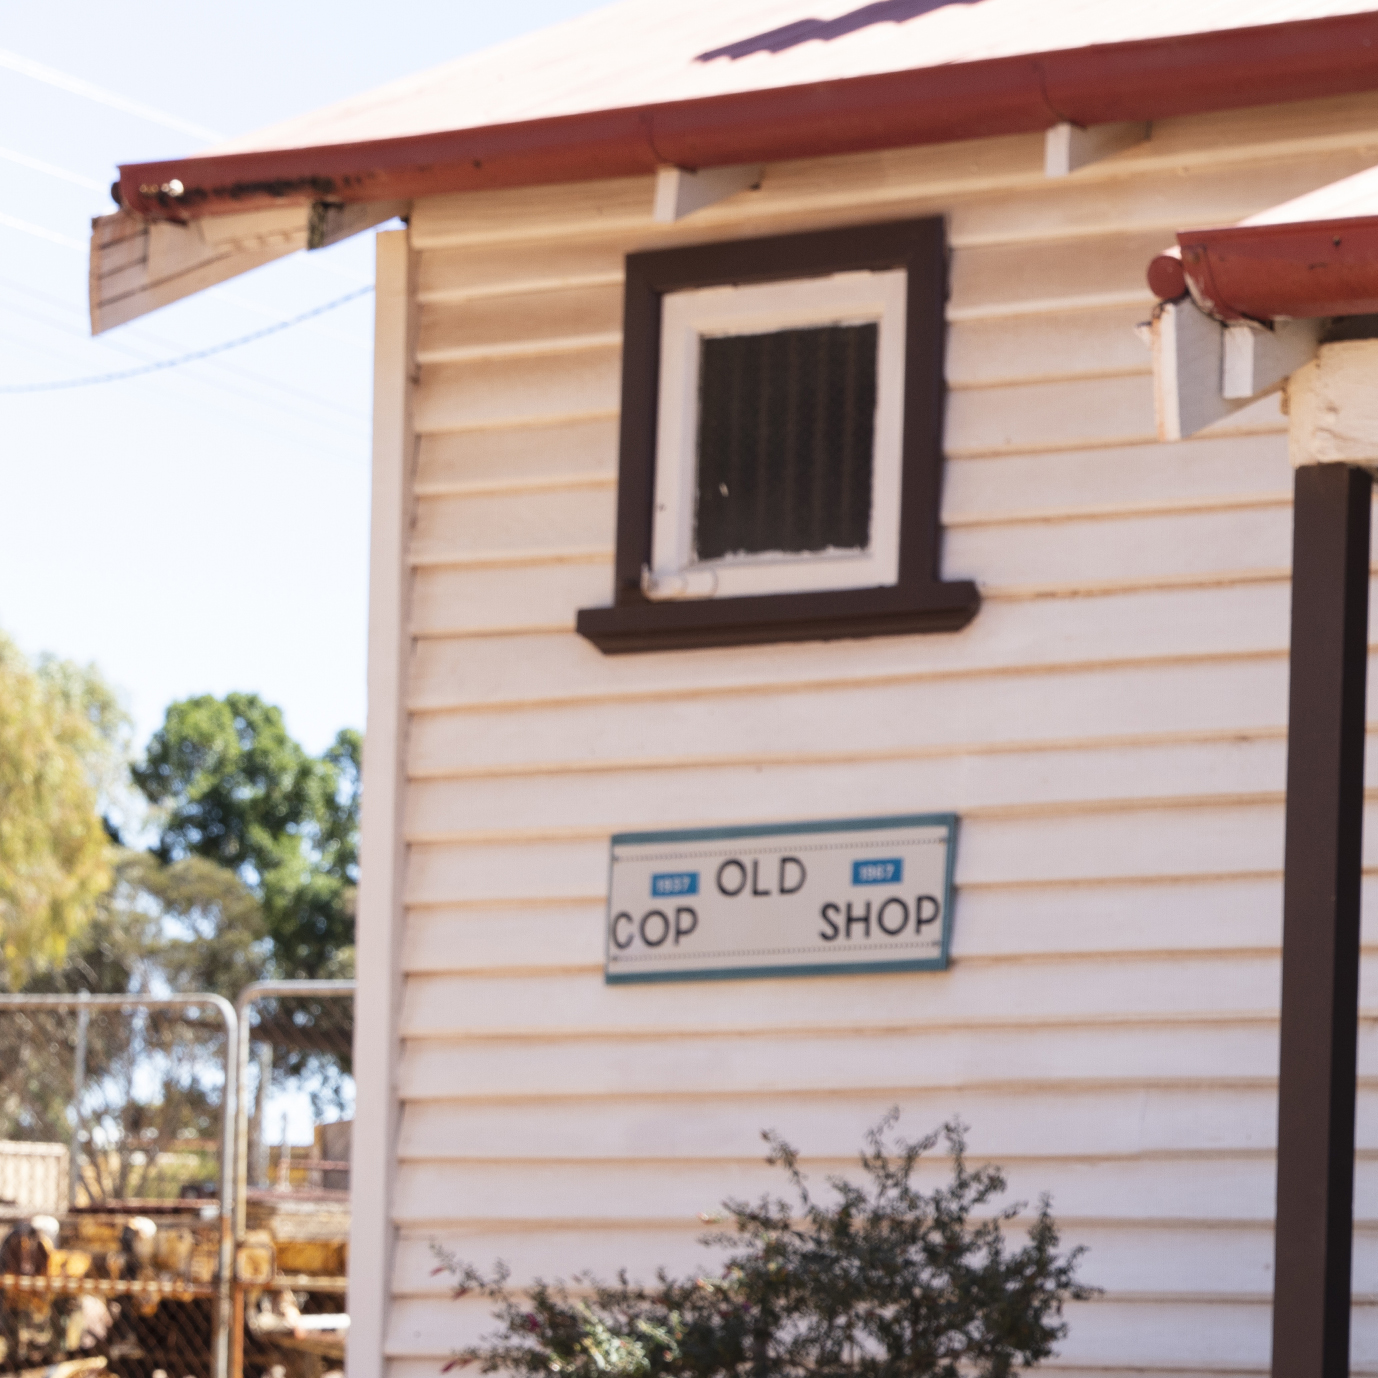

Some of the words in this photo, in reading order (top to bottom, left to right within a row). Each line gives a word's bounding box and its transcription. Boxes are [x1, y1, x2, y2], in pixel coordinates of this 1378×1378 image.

[716, 856, 807, 897] OLD
[611, 905, 698, 950] COP
[819, 895, 940, 941] SHOP
